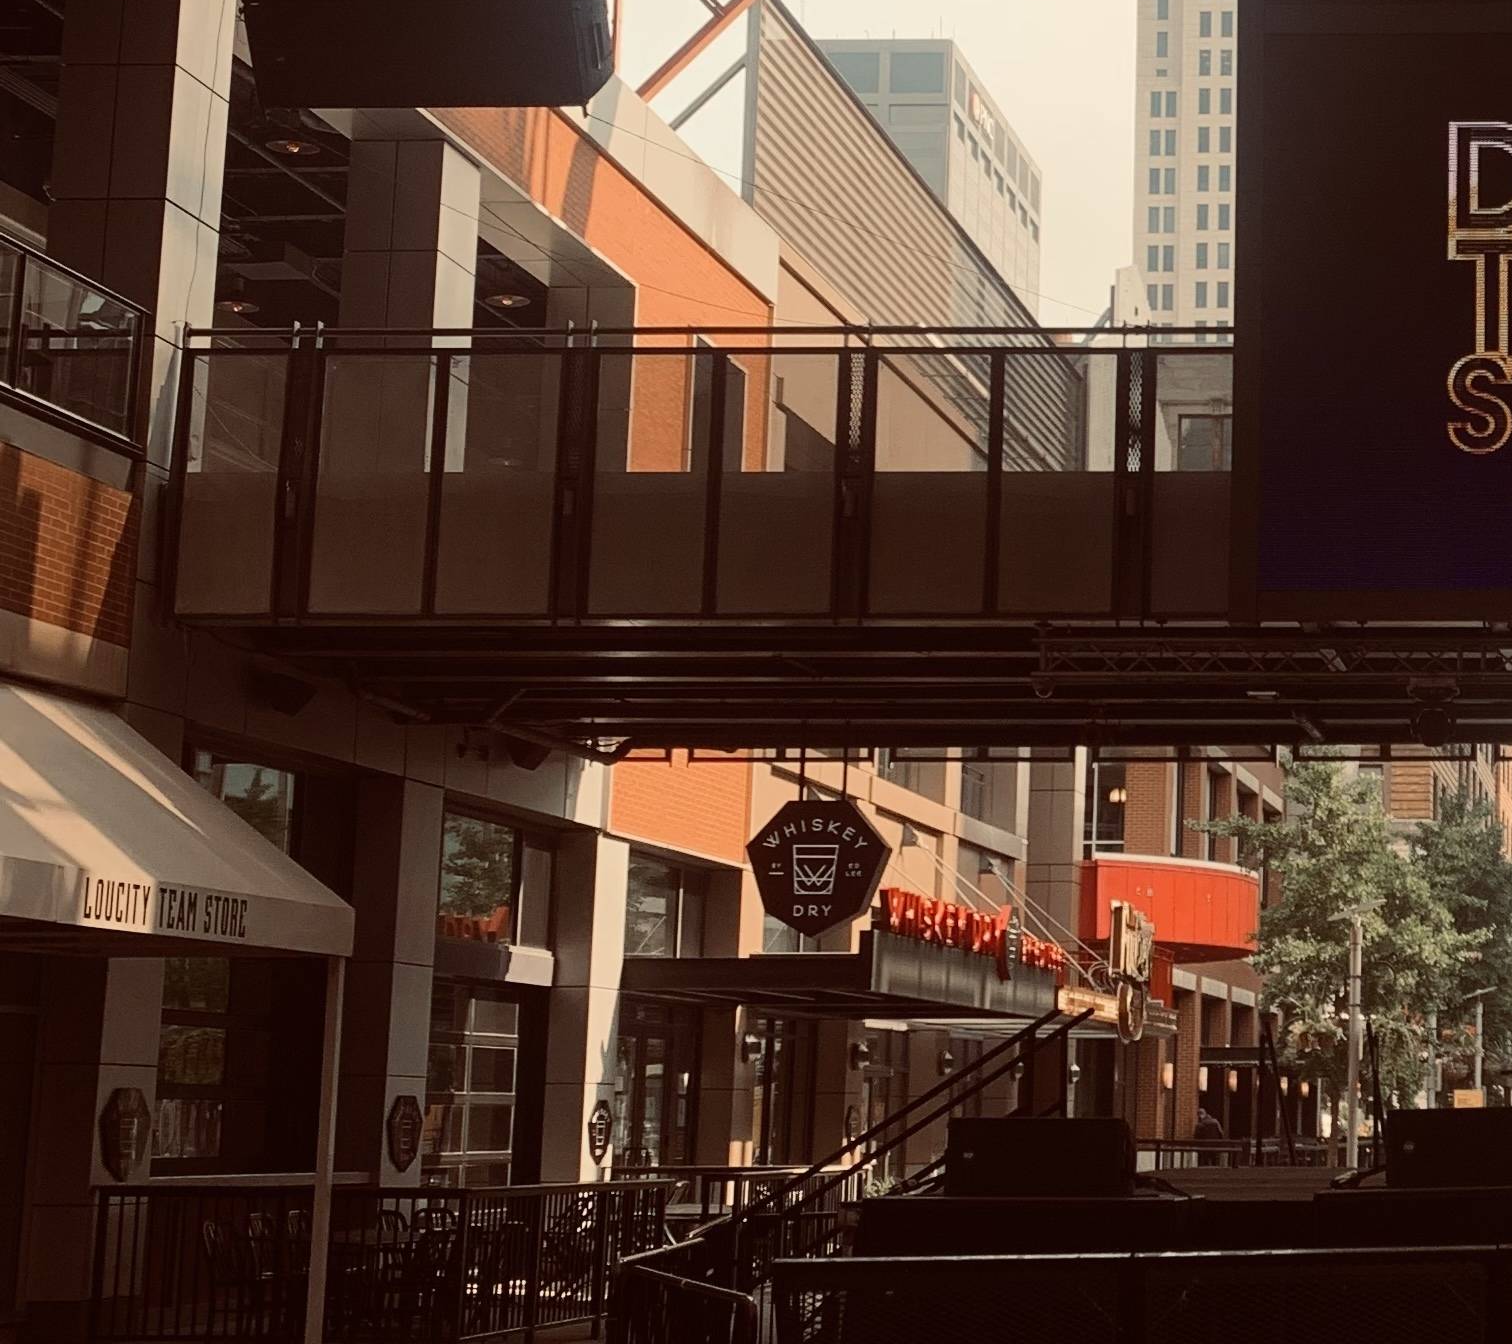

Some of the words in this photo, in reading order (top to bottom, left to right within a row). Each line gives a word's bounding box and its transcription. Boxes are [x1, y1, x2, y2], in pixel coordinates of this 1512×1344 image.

[761, 817, 869, 849] WHISKEY
[158, 887, 199, 933] TEAM
[203, 894, 248, 938] STORE
[792, 904, 833, 917] DRY
